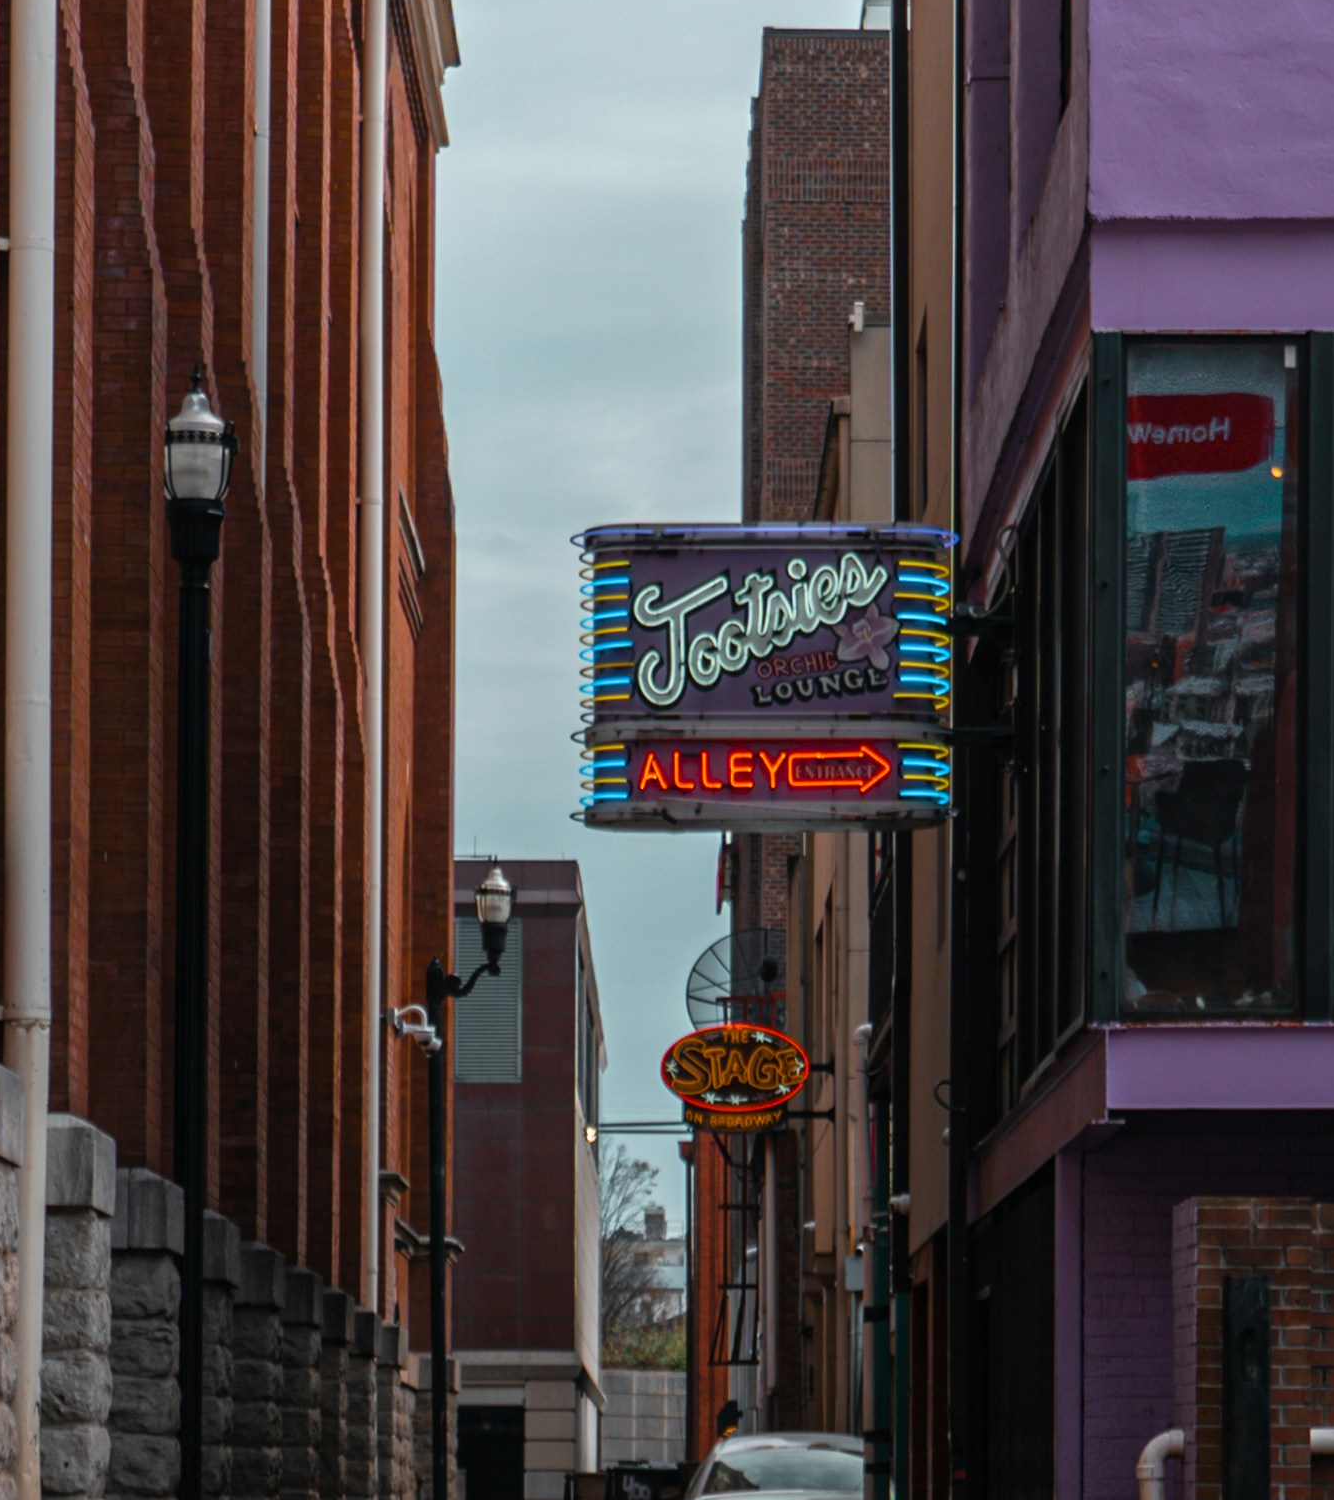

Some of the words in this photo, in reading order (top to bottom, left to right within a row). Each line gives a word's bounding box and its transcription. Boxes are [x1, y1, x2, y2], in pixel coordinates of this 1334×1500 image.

[633, 552, 888, 706] Tootsies
[757, 650, 838, 679] ORCHID
[754, 667, 888, 704] LOUNGE
[639, 750, 787, 790] ALLEY
[794, 764, 875, 781] ENTRANCE
[721, 1029, 751, 1044] THE
[671, 1037, 805, 1095] STAGE
[685, 1109, 703, 1125] ON
[709, 1108, 783, 1129] BROADWAY
